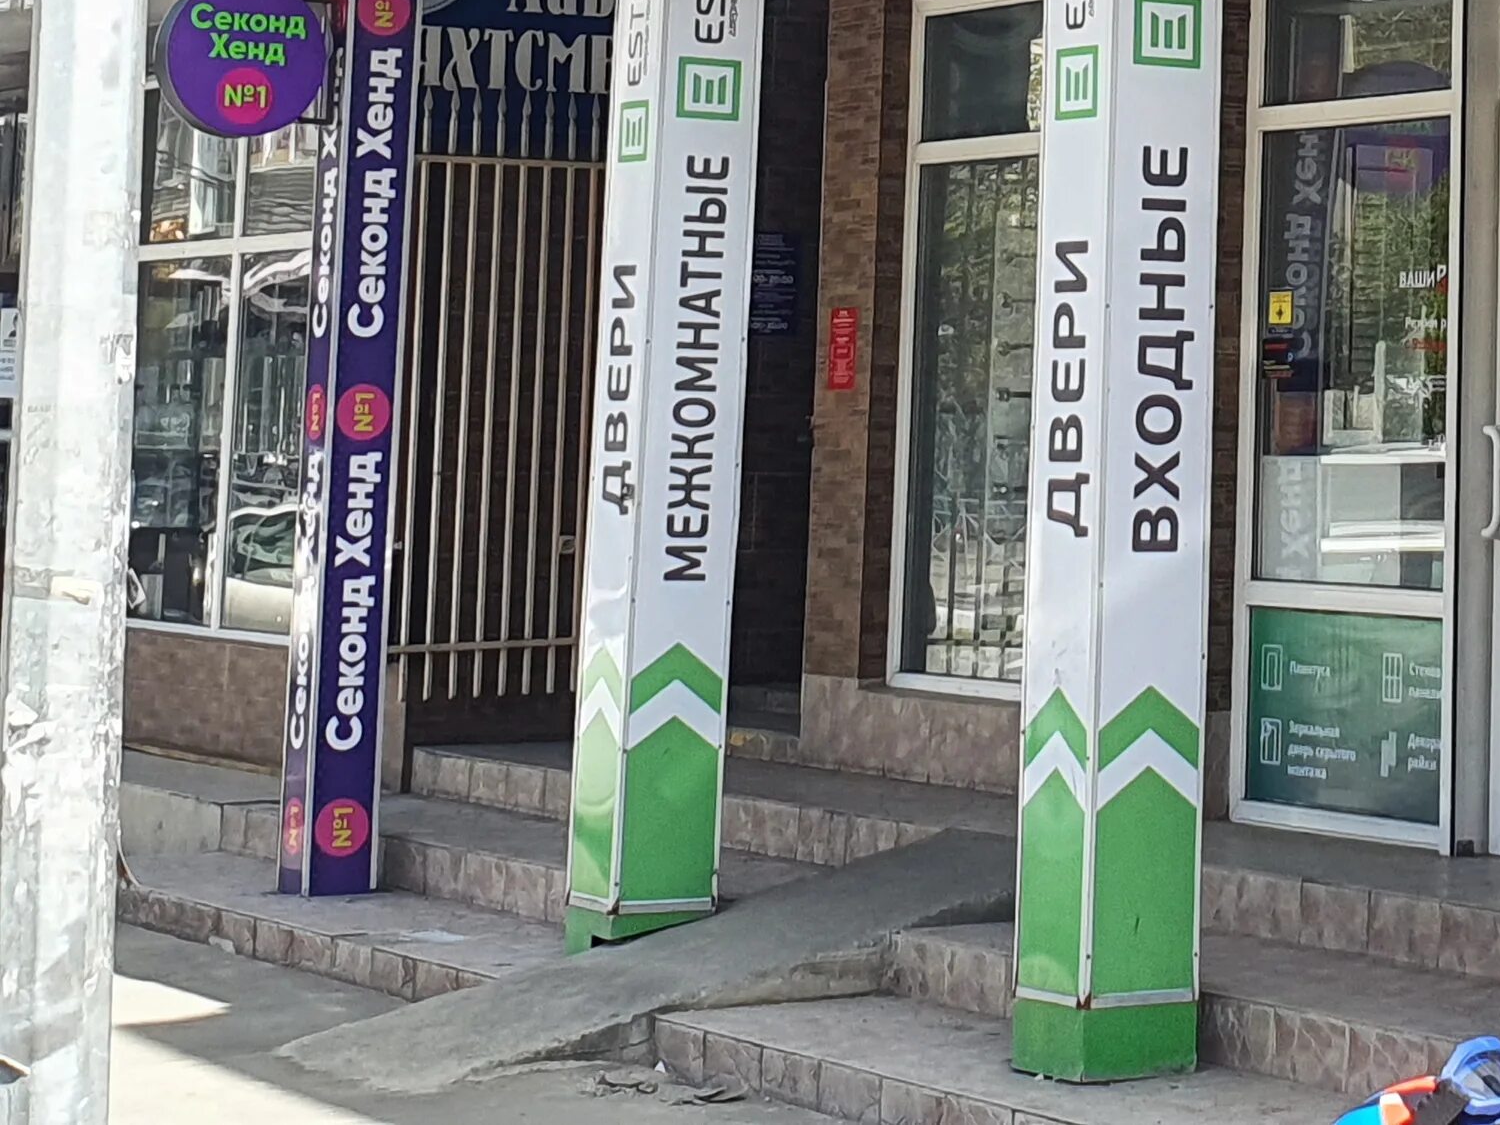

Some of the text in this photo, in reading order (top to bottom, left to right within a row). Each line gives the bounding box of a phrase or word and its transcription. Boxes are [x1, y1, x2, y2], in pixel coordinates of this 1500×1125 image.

[190, 2, 308, 40] Секонд
[208, 32, 286, 67] Хенд
[224, 82, 268, 109] №1
[355, 47, 403, 160] Хенд
[312, 166, 338, 338] Секонд
[346, 167, 398, 338] Секонд
[1399, 270, 1435, 288] ВАШИ
[602, 263, 637, 516] ДВЕРИ
[663, 154, 731, 582] МЕЖКОМНАТНЫЕ
[1047, 239, 1090, 538] ДВЕРИ
[1132, 145, 1196, 553] ВХОДНЫЕ
[325, 390, 383, 752] Секонд Хенд №1
[331, 806, 355, 849] №1
